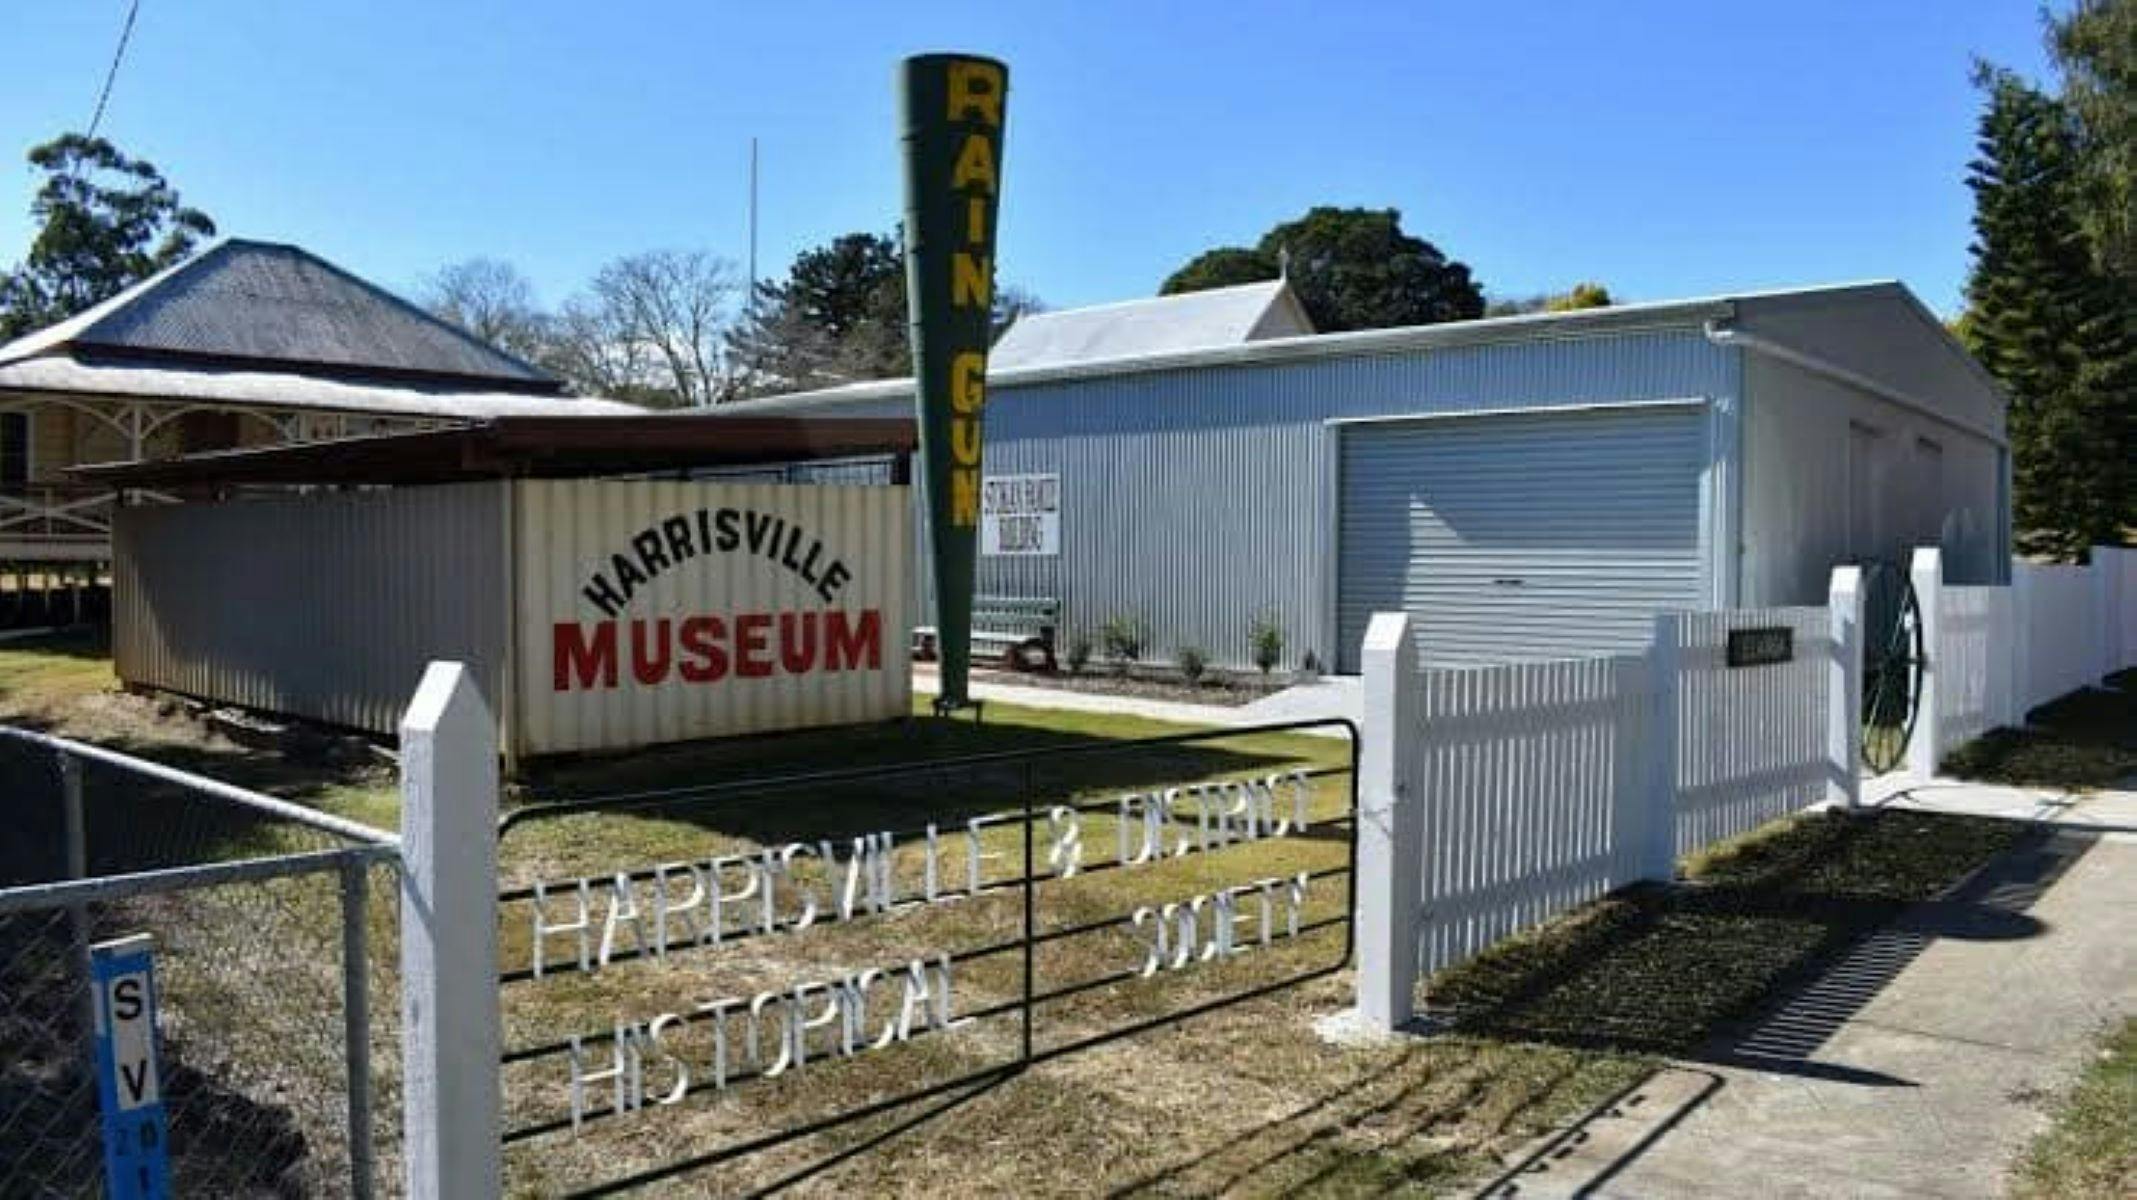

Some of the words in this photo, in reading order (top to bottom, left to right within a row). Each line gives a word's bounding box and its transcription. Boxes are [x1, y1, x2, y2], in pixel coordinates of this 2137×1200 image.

[946, 60, 1002, 307] RAIN
[950, 352, 986, 527] GUN
[553, 609, 882, 692] MUSEUM
[582, 507, 852, 618] HARRISVILLE
[533, 816, 1003, 979] HARRISVILLE
[1049, 804, 1082, 879] &
[1119, 768, 1314, 865] DISTRICT
[570, 951, 977, 1132] HISTORICAL
